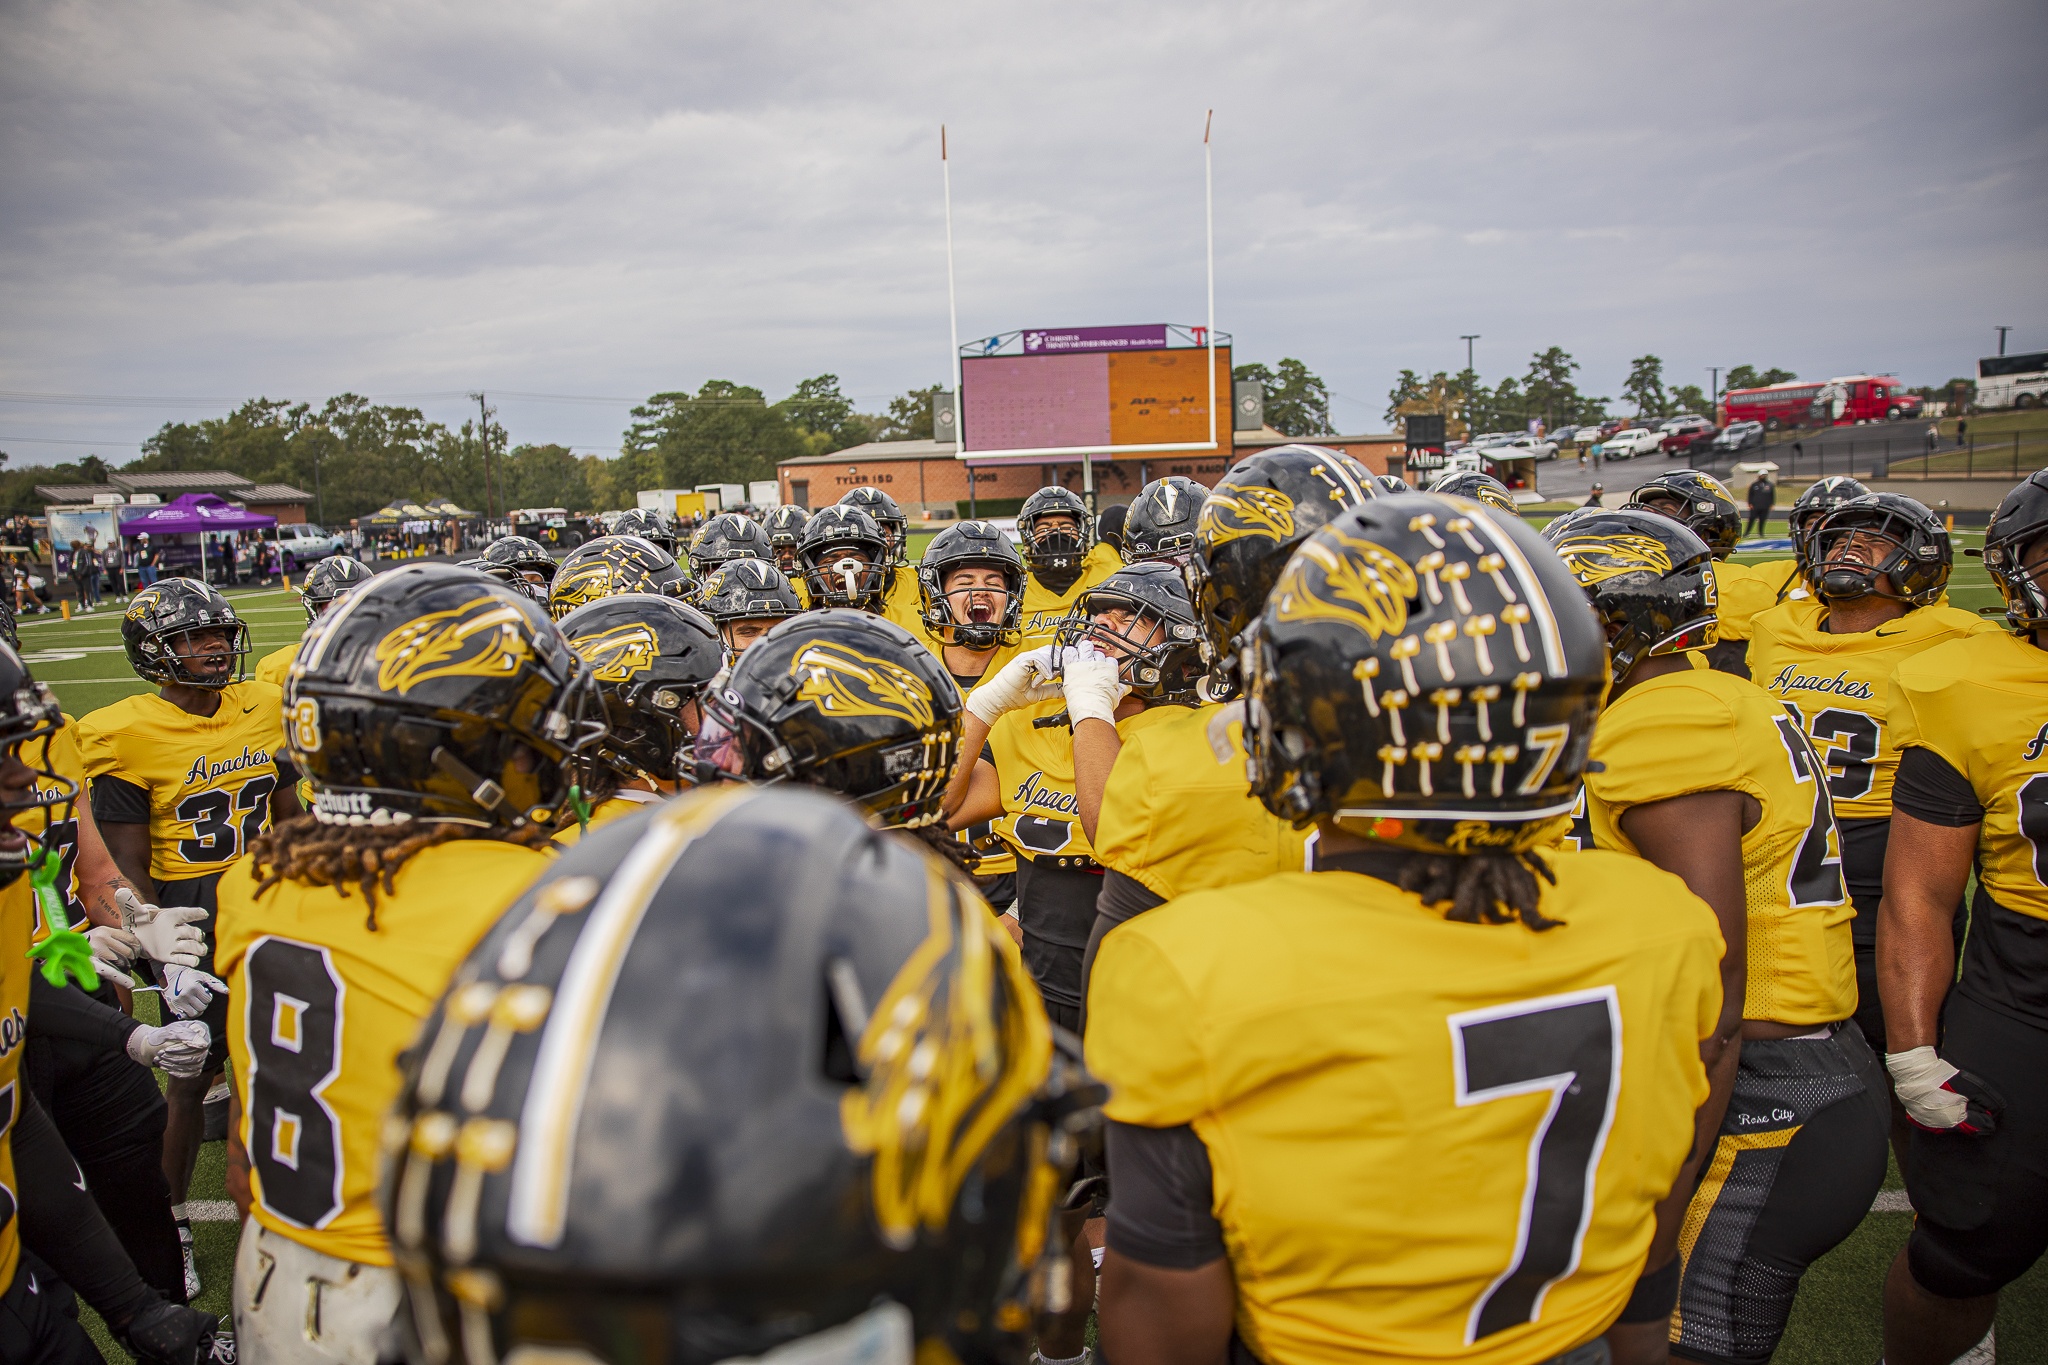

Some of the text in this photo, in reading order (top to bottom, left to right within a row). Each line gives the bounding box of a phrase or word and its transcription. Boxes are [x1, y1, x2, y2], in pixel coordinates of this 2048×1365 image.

[836, 474, 893, 485] TYLER ISD
[1768, 664, 1874, 700] Apaches
[295, 696, 322, 752] 8
[1779, 700, 1881, 800] 3
[184, 745, 271, 785] Apaches
[1516, 723, 1570, 796] 7
[175, 774, 277, 864] 32
[245, 934, 346, 1231] 8
[1739, 1108, 1795, 1125] Rose City
[1447, 985, 1622, 1346] 7
